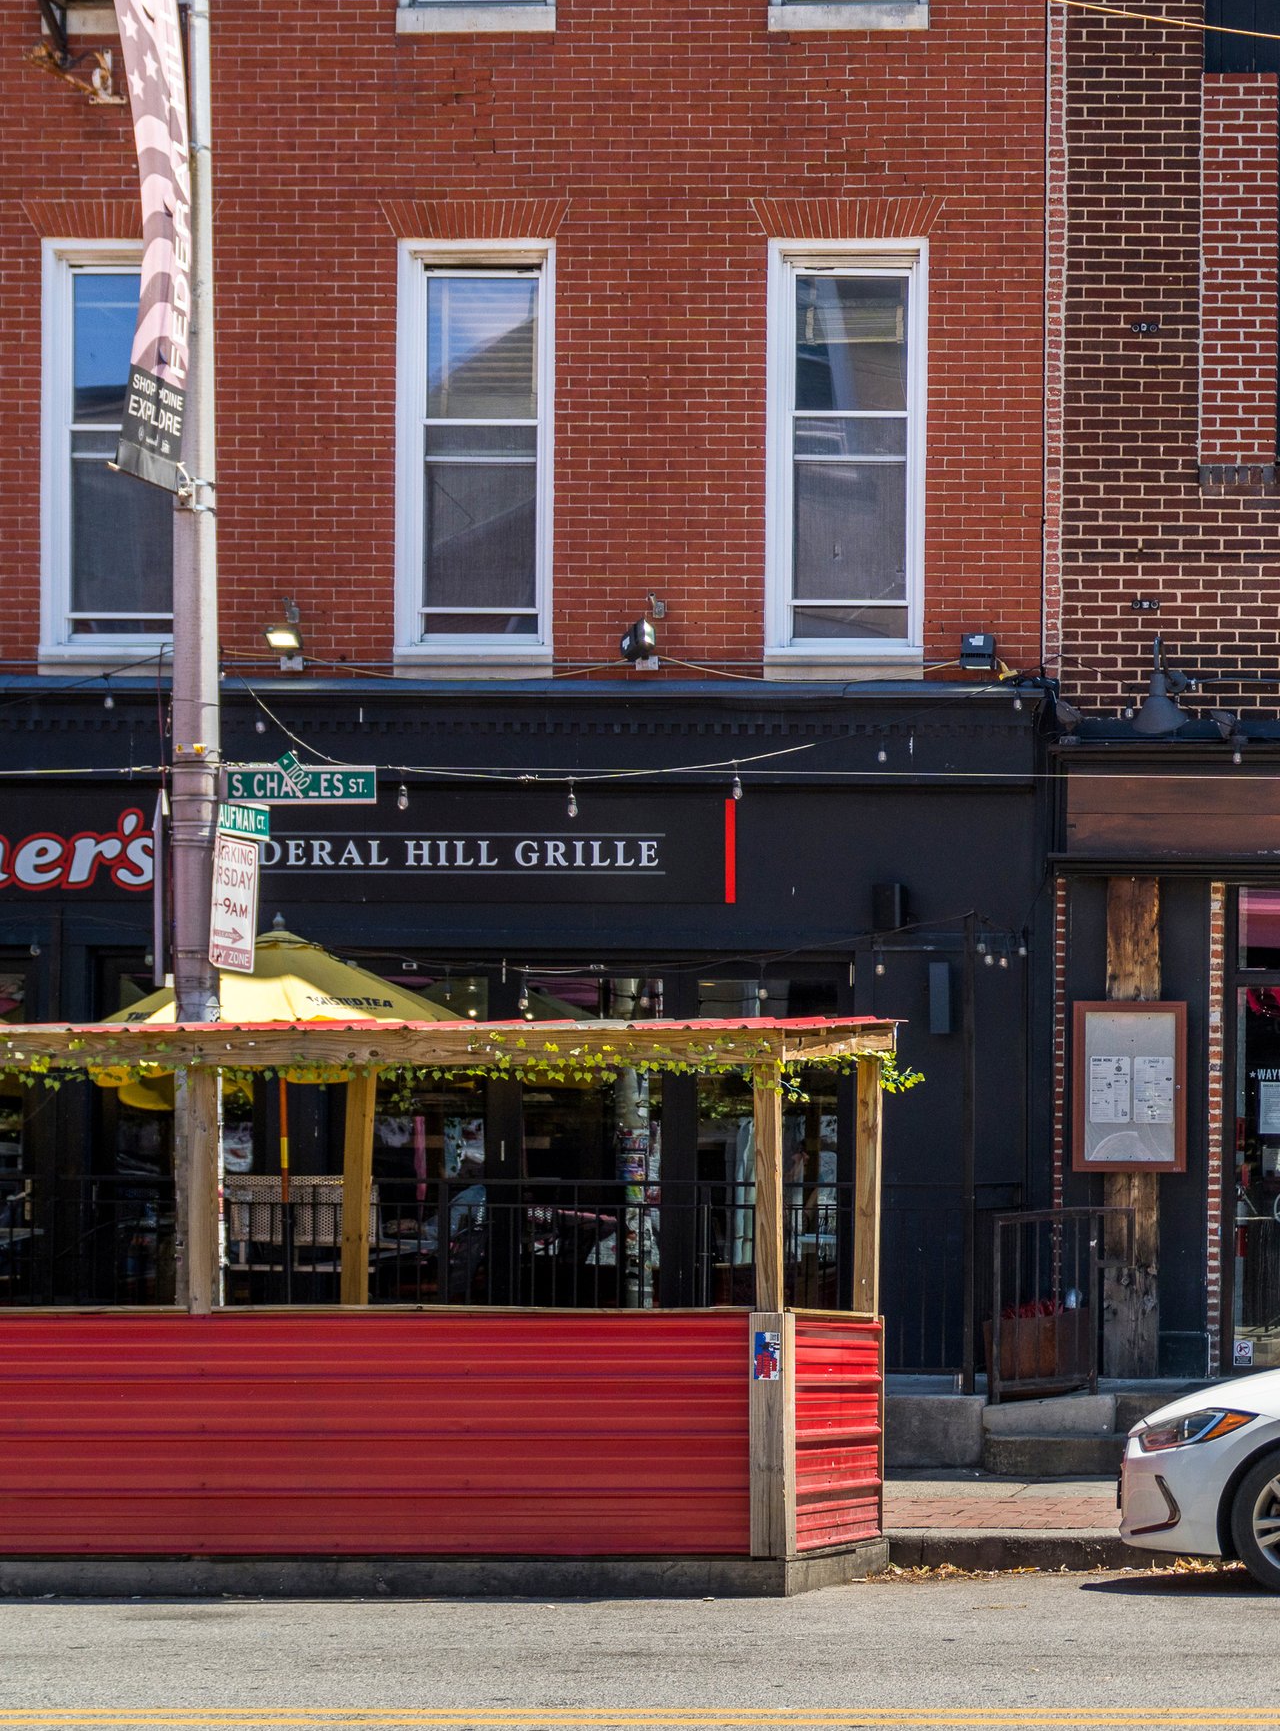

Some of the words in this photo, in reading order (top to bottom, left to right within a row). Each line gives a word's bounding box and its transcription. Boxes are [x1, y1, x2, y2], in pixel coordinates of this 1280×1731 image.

[167, 137, 192, 379] FEDERAL
[132, 373, 157, 396] SHOP
[163, 389, 184, 411] DINE
[128, 394, 183, 437] EXPLORE
[231, 773, 248, 797] S.
[253, 773, 344, 797] CHALES
[348, 778, 367, 793] ST.
[286, 763, 310, 790] 1100
[219, 804, 255, 832] AUFMAN
[256, 814, 266, 831] CT.
[257, 840, 389, 866] DERAL
[404, 840, 499, 867] HILL
[515, 840, 660, 867] GRILLE
[228, 951, 250, 967] ZONE
